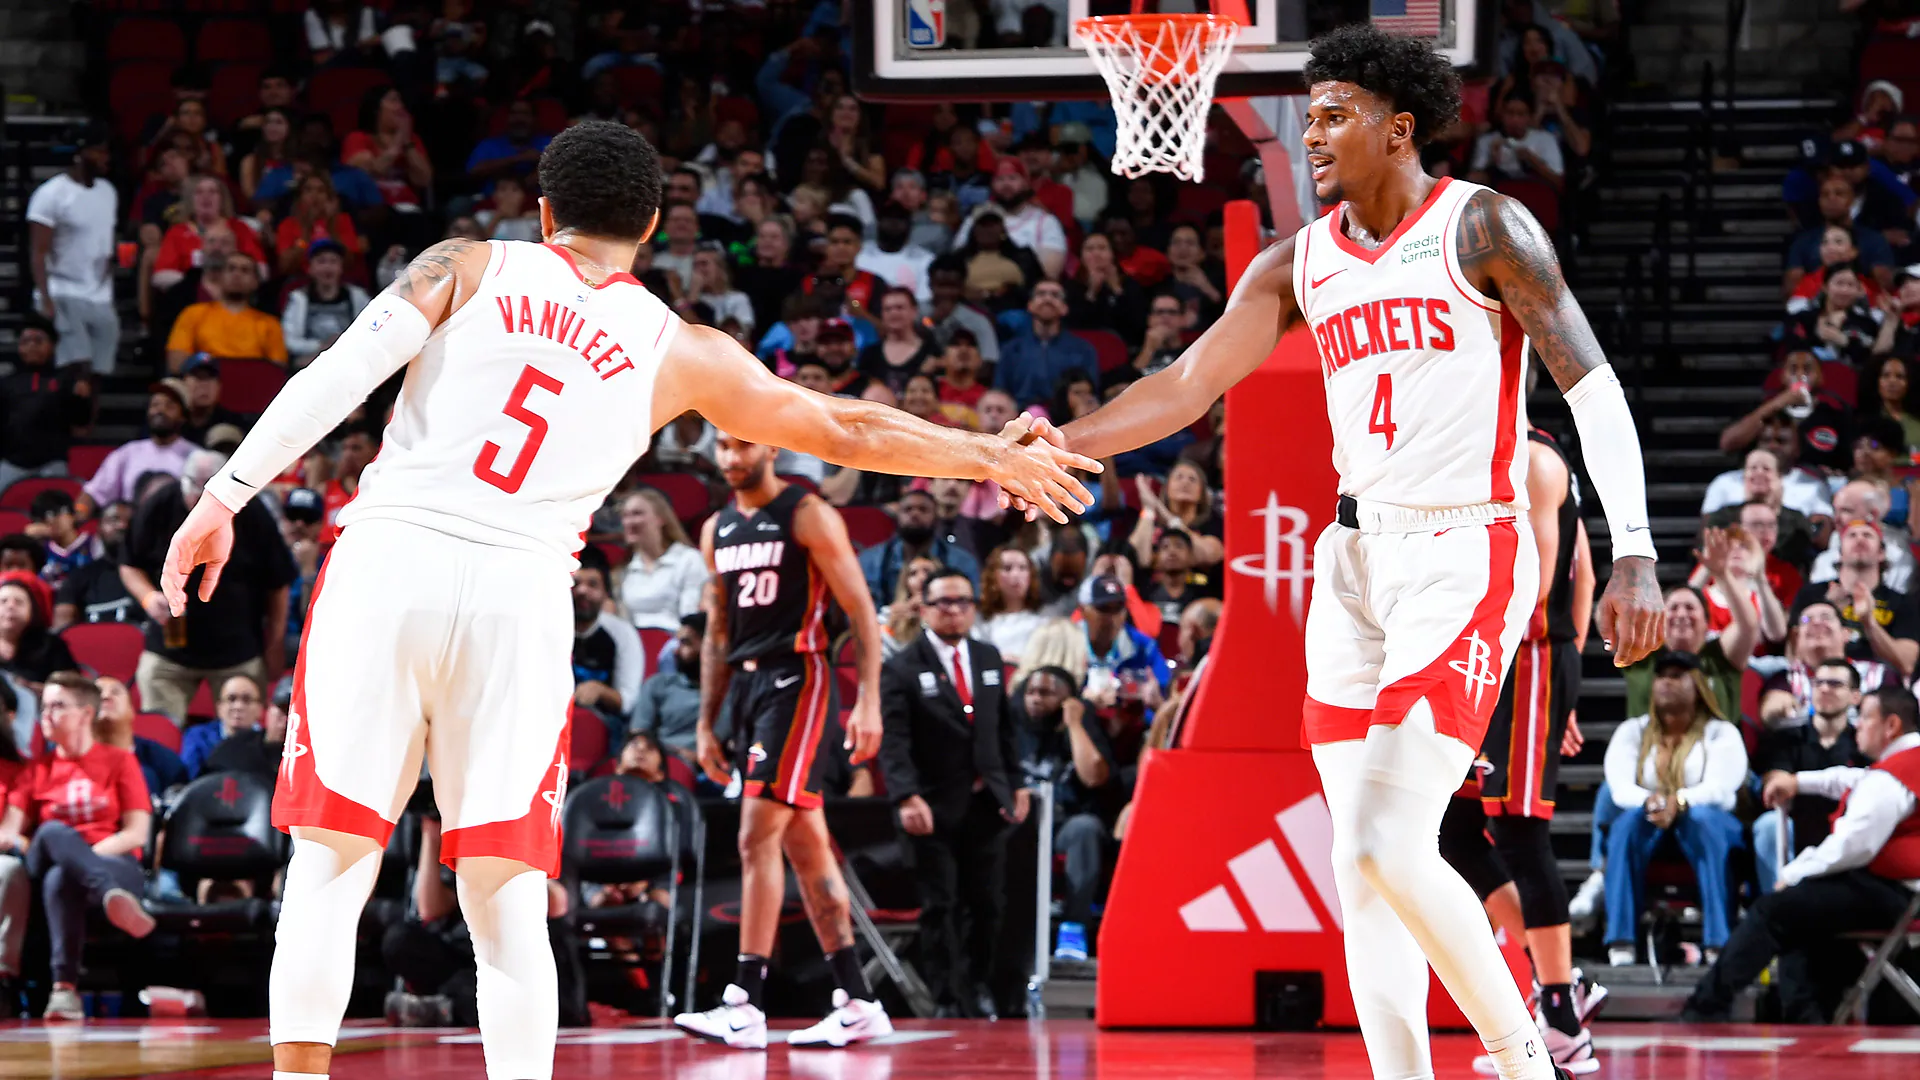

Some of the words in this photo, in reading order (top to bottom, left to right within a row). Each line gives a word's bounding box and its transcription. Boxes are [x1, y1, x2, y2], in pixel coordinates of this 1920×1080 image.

[1401, 248, 1440, 265] karma
[1402, 234, 1439, 252] credit
[495, 295, 635, 381] VANVLEET
[1315, 297, 1456, 379] ROCKETS
[473, 363, 565, 494] 5
[1368, 373, 1398, 451] 4
[737, 569, 780, 608] 20
